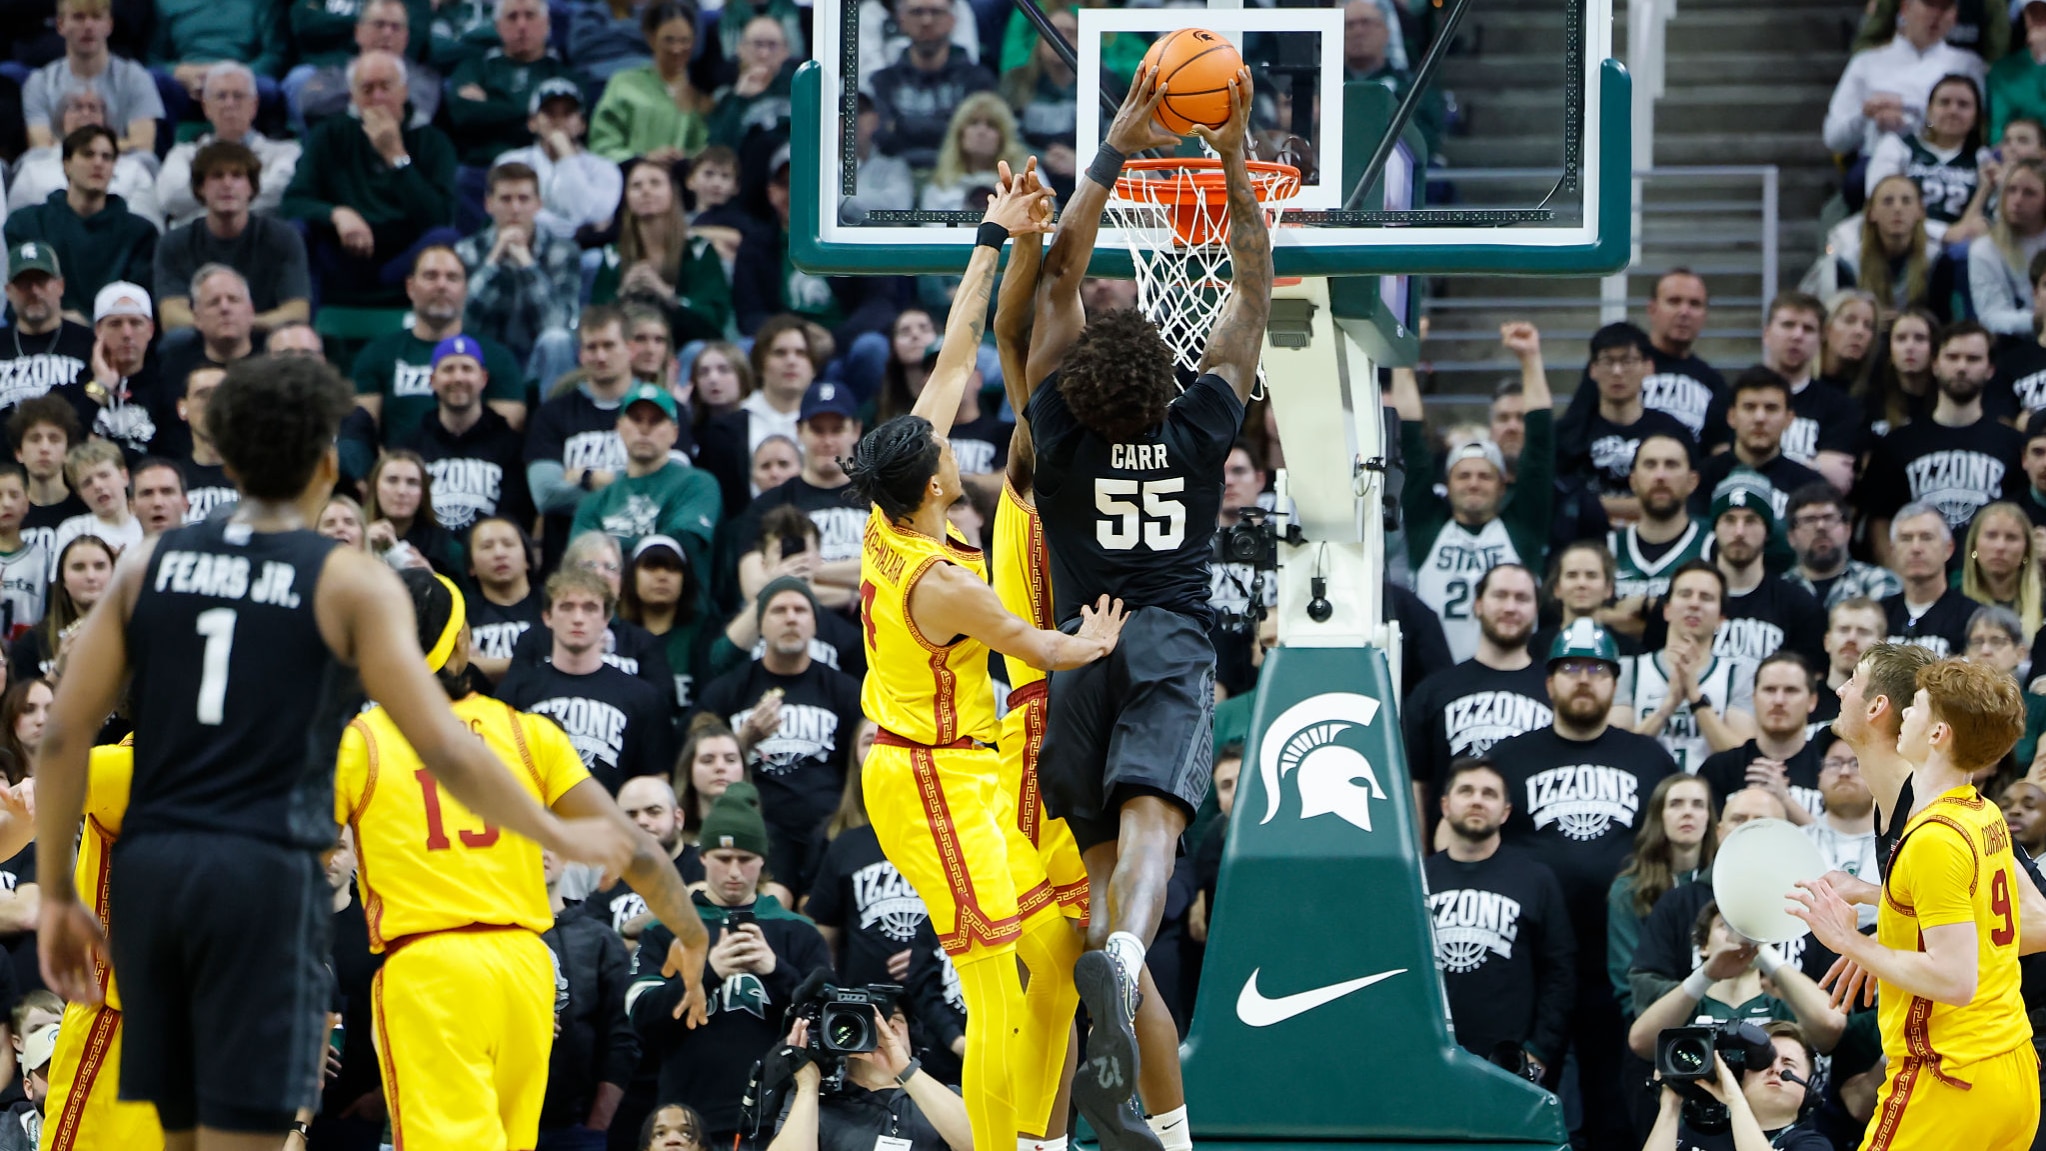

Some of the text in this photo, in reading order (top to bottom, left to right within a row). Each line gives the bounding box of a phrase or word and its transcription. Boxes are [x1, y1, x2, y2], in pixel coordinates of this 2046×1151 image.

[1111, 443, 1170, 470] CARR
[1905, 449, 2006, 501] IZZONE
[1094, 476, 1187, 552] 55
[155, 551, 301, 609] FEARS JR.
[861, 578, 877, 654] 4
[196, 607, 237, 726] 1
[1444, 690, 1554, 741] IZZONE
[1525, 763, 1639, 816] IZZONE
[1990, 868, 2015, 947] 9
